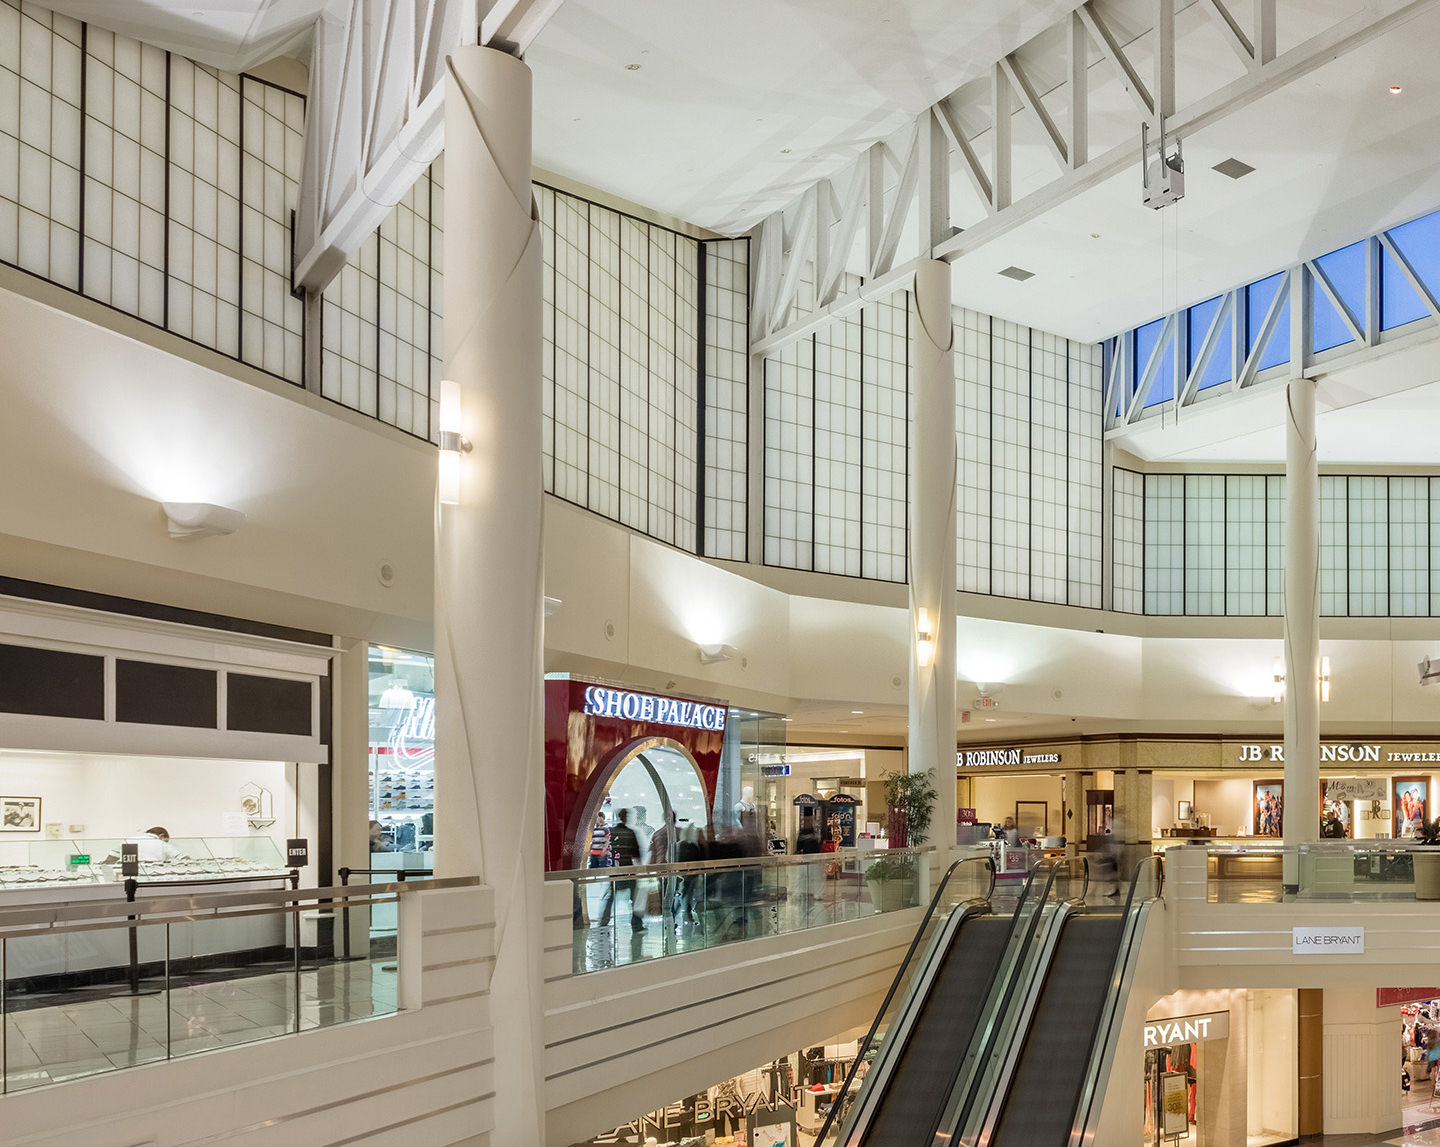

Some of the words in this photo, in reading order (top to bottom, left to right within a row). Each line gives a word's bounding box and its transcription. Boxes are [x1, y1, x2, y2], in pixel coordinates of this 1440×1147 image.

[592, 687, 656, 720] SHOE
[657, 697, 726, 731] PALACE
[966, 749, 1021, 766] ROBINSON
[1023, 753, 1059, 764] JEWELERS
[1239, 745, 1262, 762] JB
[1269, 745, 1381, 762] RNSON
[123, 854, 137, 863] EXIT
[288, 848, 307, 857] ENTER
[1296, 935, 1322, 945] LANE
[1324, 935, 1361, 945] BRYANT
[1143, 1017, 1212, 1047] RYANT
[694, 1084, 813, 1124] BRYANT
